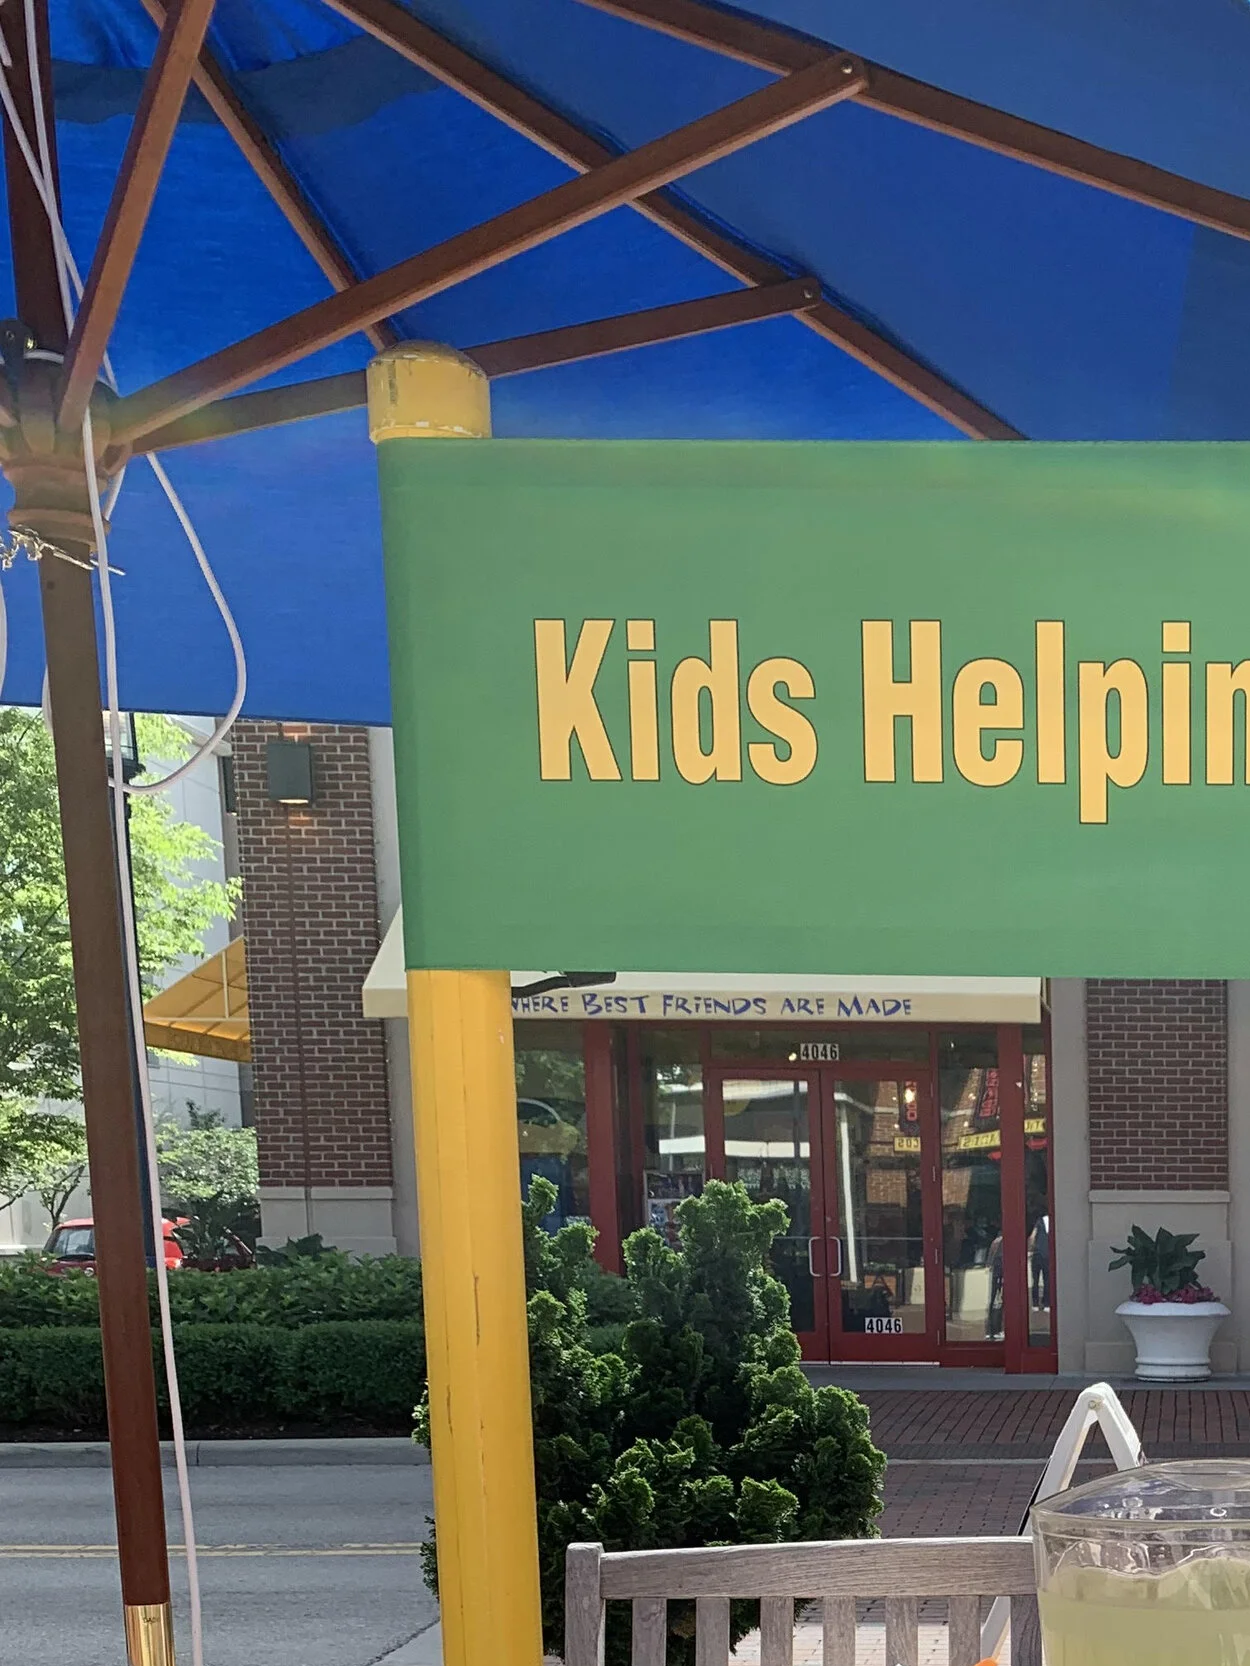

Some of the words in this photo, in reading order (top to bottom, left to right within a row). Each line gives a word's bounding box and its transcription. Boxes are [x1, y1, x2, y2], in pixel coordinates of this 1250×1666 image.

[533, 618, 818, 786] Kids
[582, 993, 650, 1016] BEST
[780, 997, 825, 1015] ARE
[837, 995, 912, 1016] MADE
[802, 1044, 837, 1059] 4046
[866, 1318, 901, 1333] 4046
